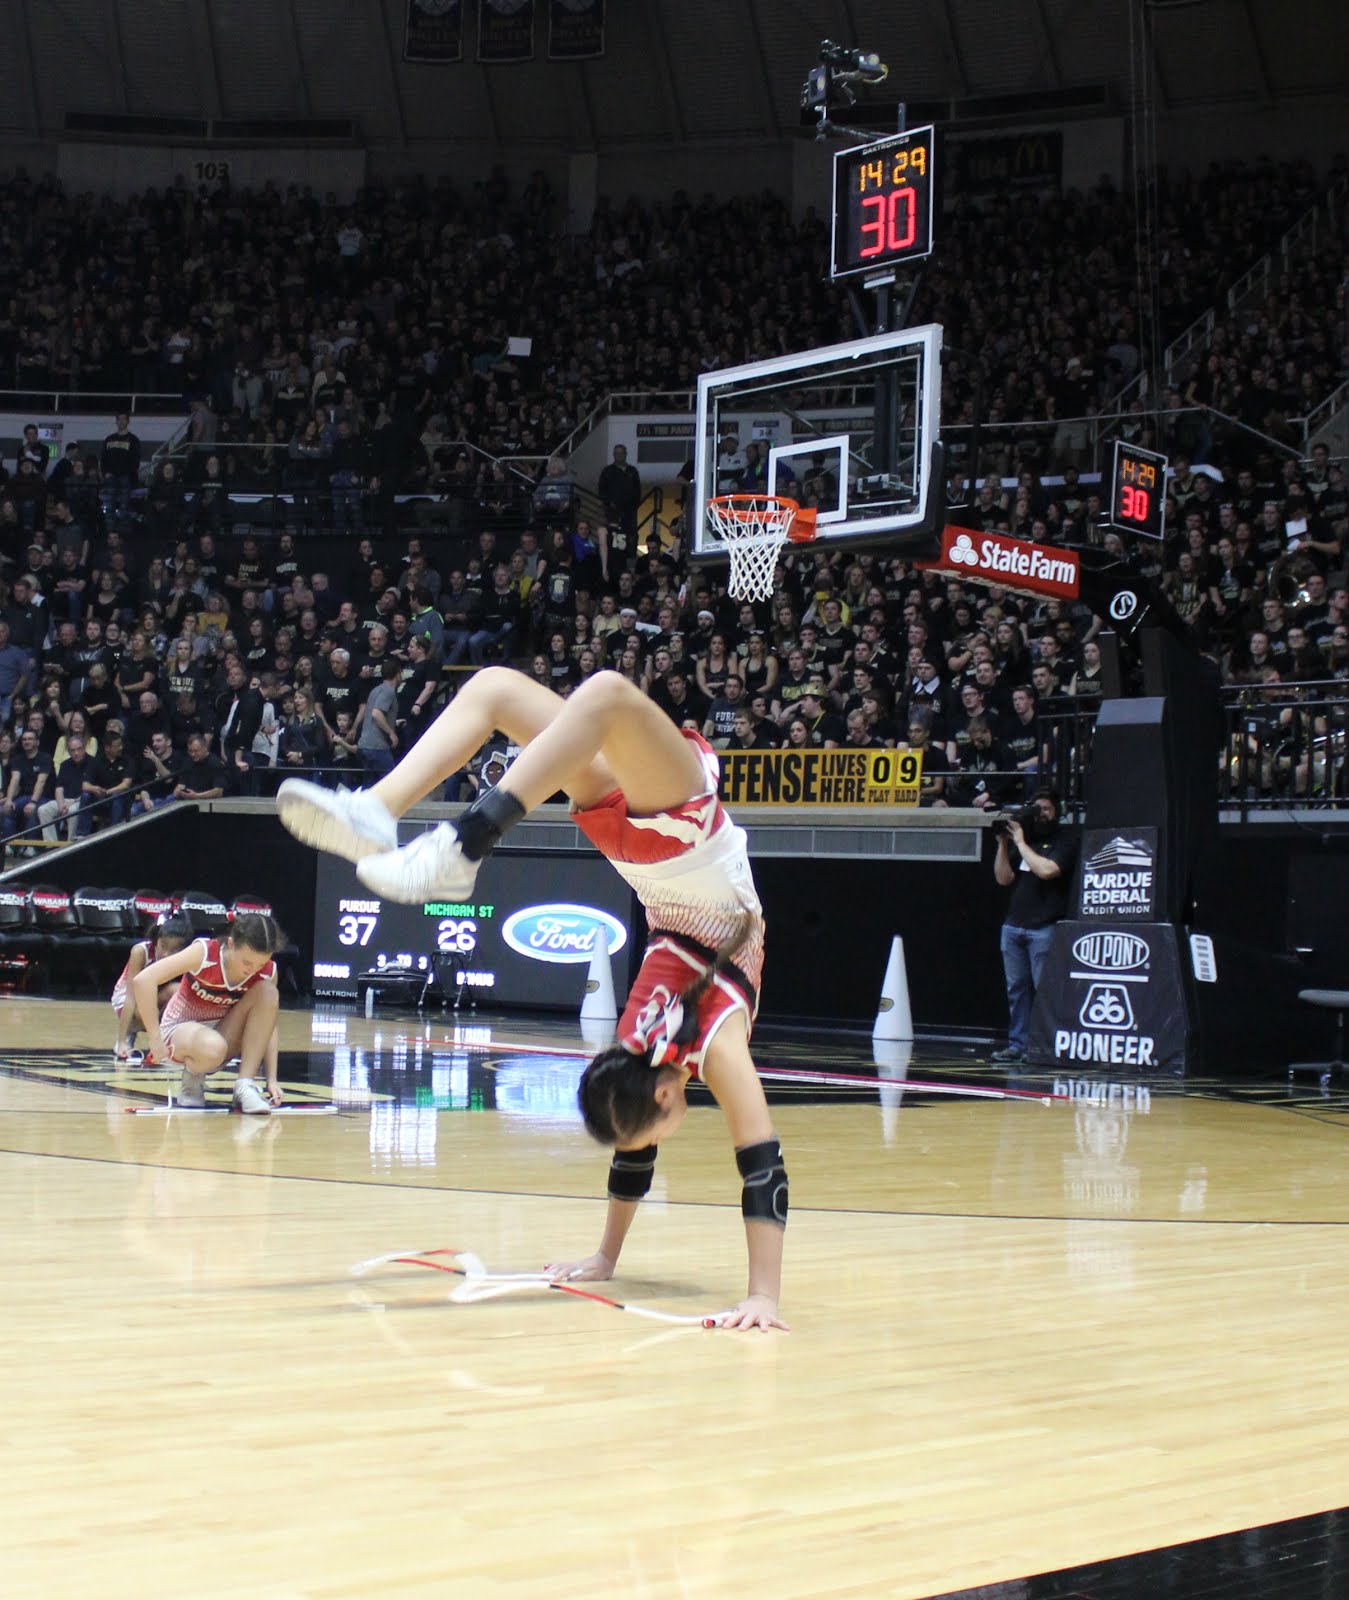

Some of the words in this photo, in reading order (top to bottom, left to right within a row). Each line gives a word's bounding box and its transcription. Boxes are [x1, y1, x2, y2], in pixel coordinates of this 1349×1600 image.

[195, 161, 229, 181] 103
[859, 186, 917, 258] 30
[1121, 485, 1149, 522] 30
[821, 753, 867, 777] LIVES
[718, 753, 819, 803] EFENSE
[819, 777, 865, 803] HERE
[868, 789, 890, 803] PLAY
[894, 789, 918, 803] HARD
[1083, 872, 1153, 889] PURDUE
[33, 898, 70, 907] WABASH
[1083, 888, 1151, 905] FEDERAL
[134, 901, 172, 911] WABASH
[181, 902, 227, 912] COOPER
[339, 899, 381, 914] PURDUE
[424, 903, 475, 918] MICHIGAN
[478, 904, 495, 918] ST
[1082, 905, 1115, 915] CREDIT
[1117, 904, 1151, 914] UNION
[338, 916, 377, 946] 37
[438, 919, 478, 951] 26
[530, 916, 598, 950] Ford
[313, 963, 350, 979] BONUS
[315, 989, 359, 998] DAKTRONIC
[1055, 1029, 1155, 1067] PIONEER
